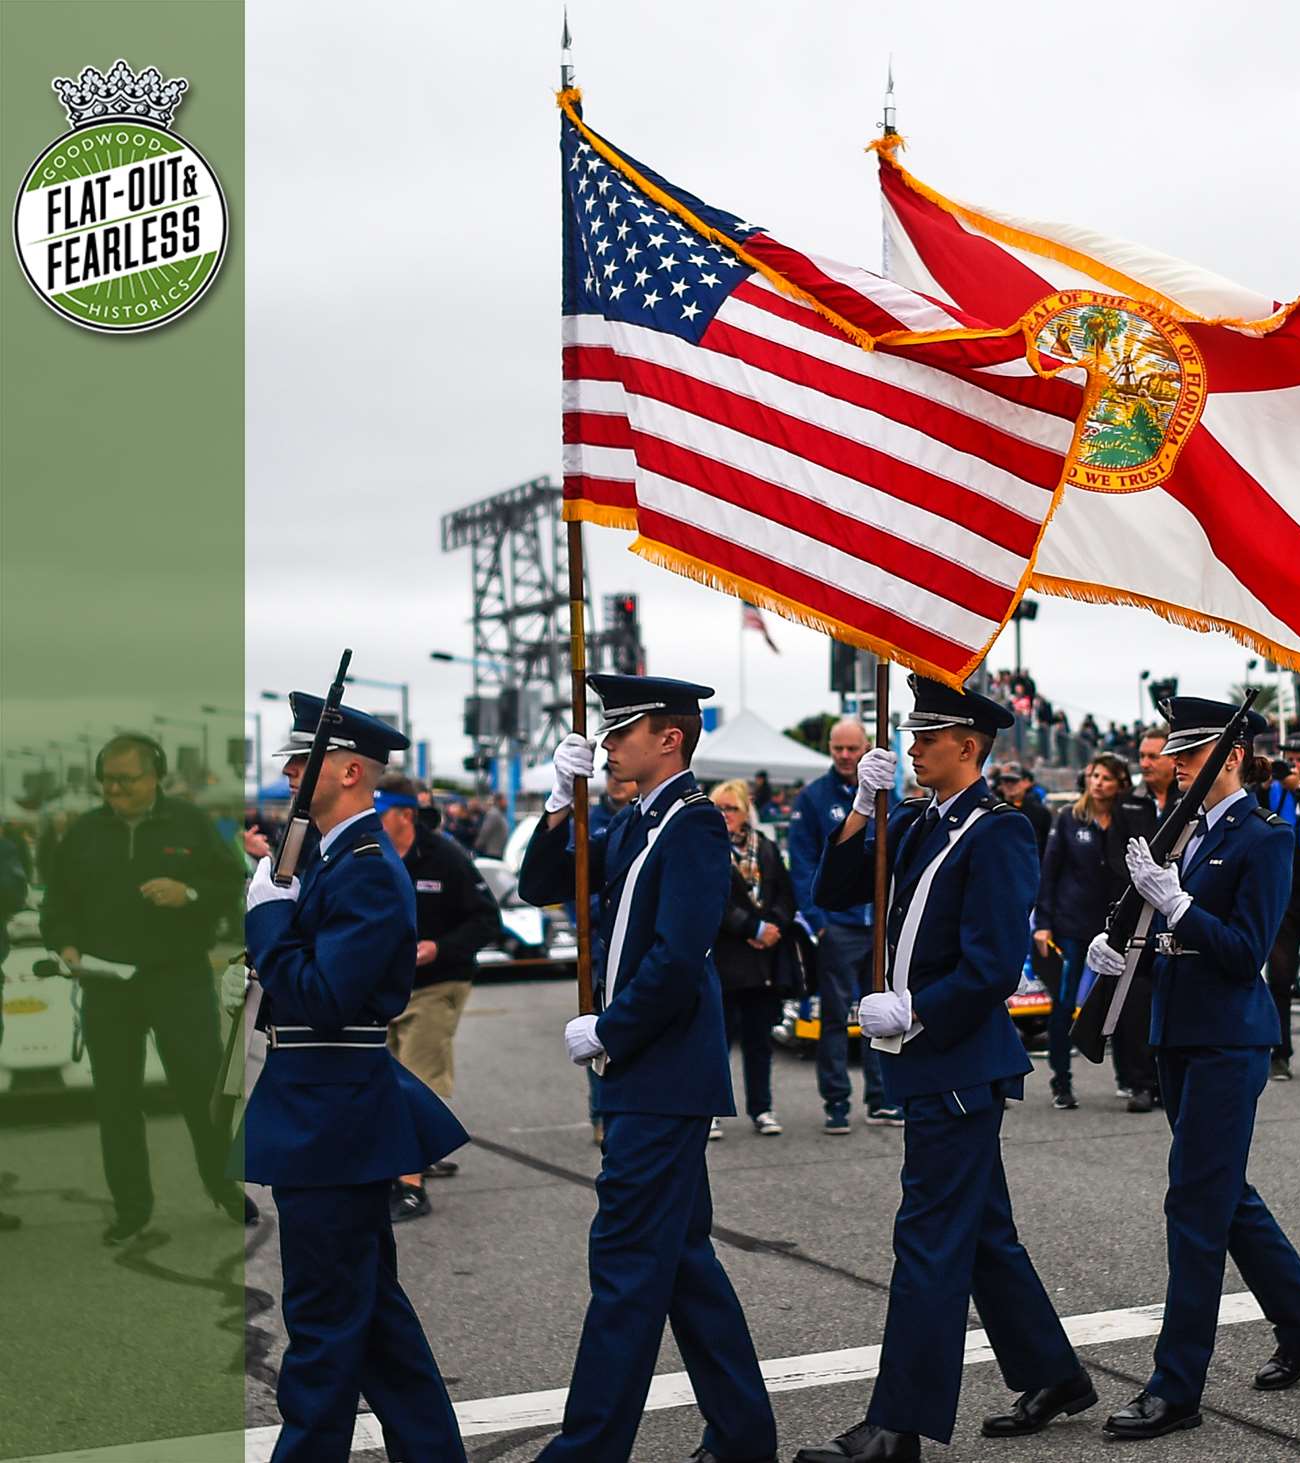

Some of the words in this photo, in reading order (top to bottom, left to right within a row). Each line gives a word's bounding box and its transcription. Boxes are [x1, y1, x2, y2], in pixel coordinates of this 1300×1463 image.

[1058, 293, 1083, 307] OF
[1092, 294, 1128, 309] THE
[1179, 344, 1198, 366] OF
[1170, 368, 1202, 447] FLORIDA
[1085, 472, 1111, 487] WE
[1117, 463, 1166, 488] TRUST
